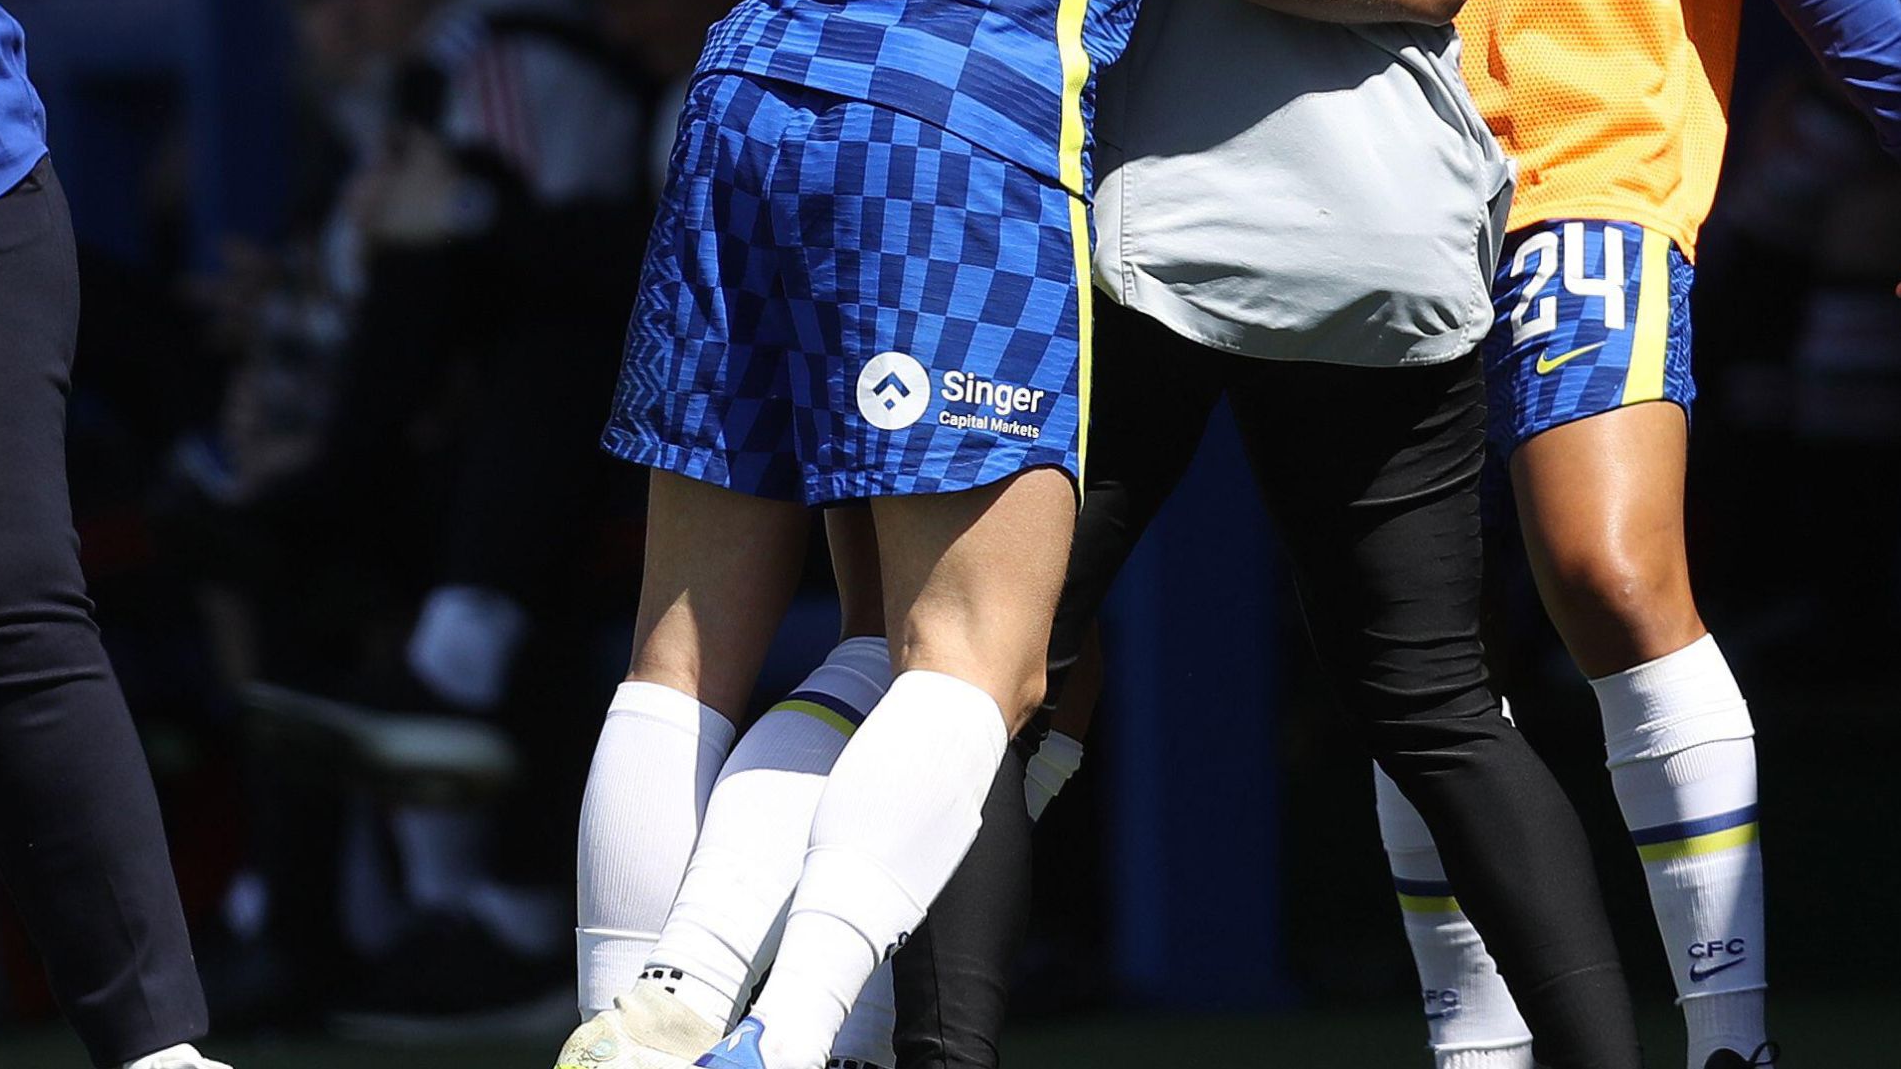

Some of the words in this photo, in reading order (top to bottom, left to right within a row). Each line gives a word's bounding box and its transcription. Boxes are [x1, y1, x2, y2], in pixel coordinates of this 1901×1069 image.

[1510, 221, 1625, 346] 24
[941, 370, 1044, 415] Singer
[939, 411, 988, 430] Capital
[990, 417, 1040, 439] Markets
[1688, 938, 1745, 959] CFC
